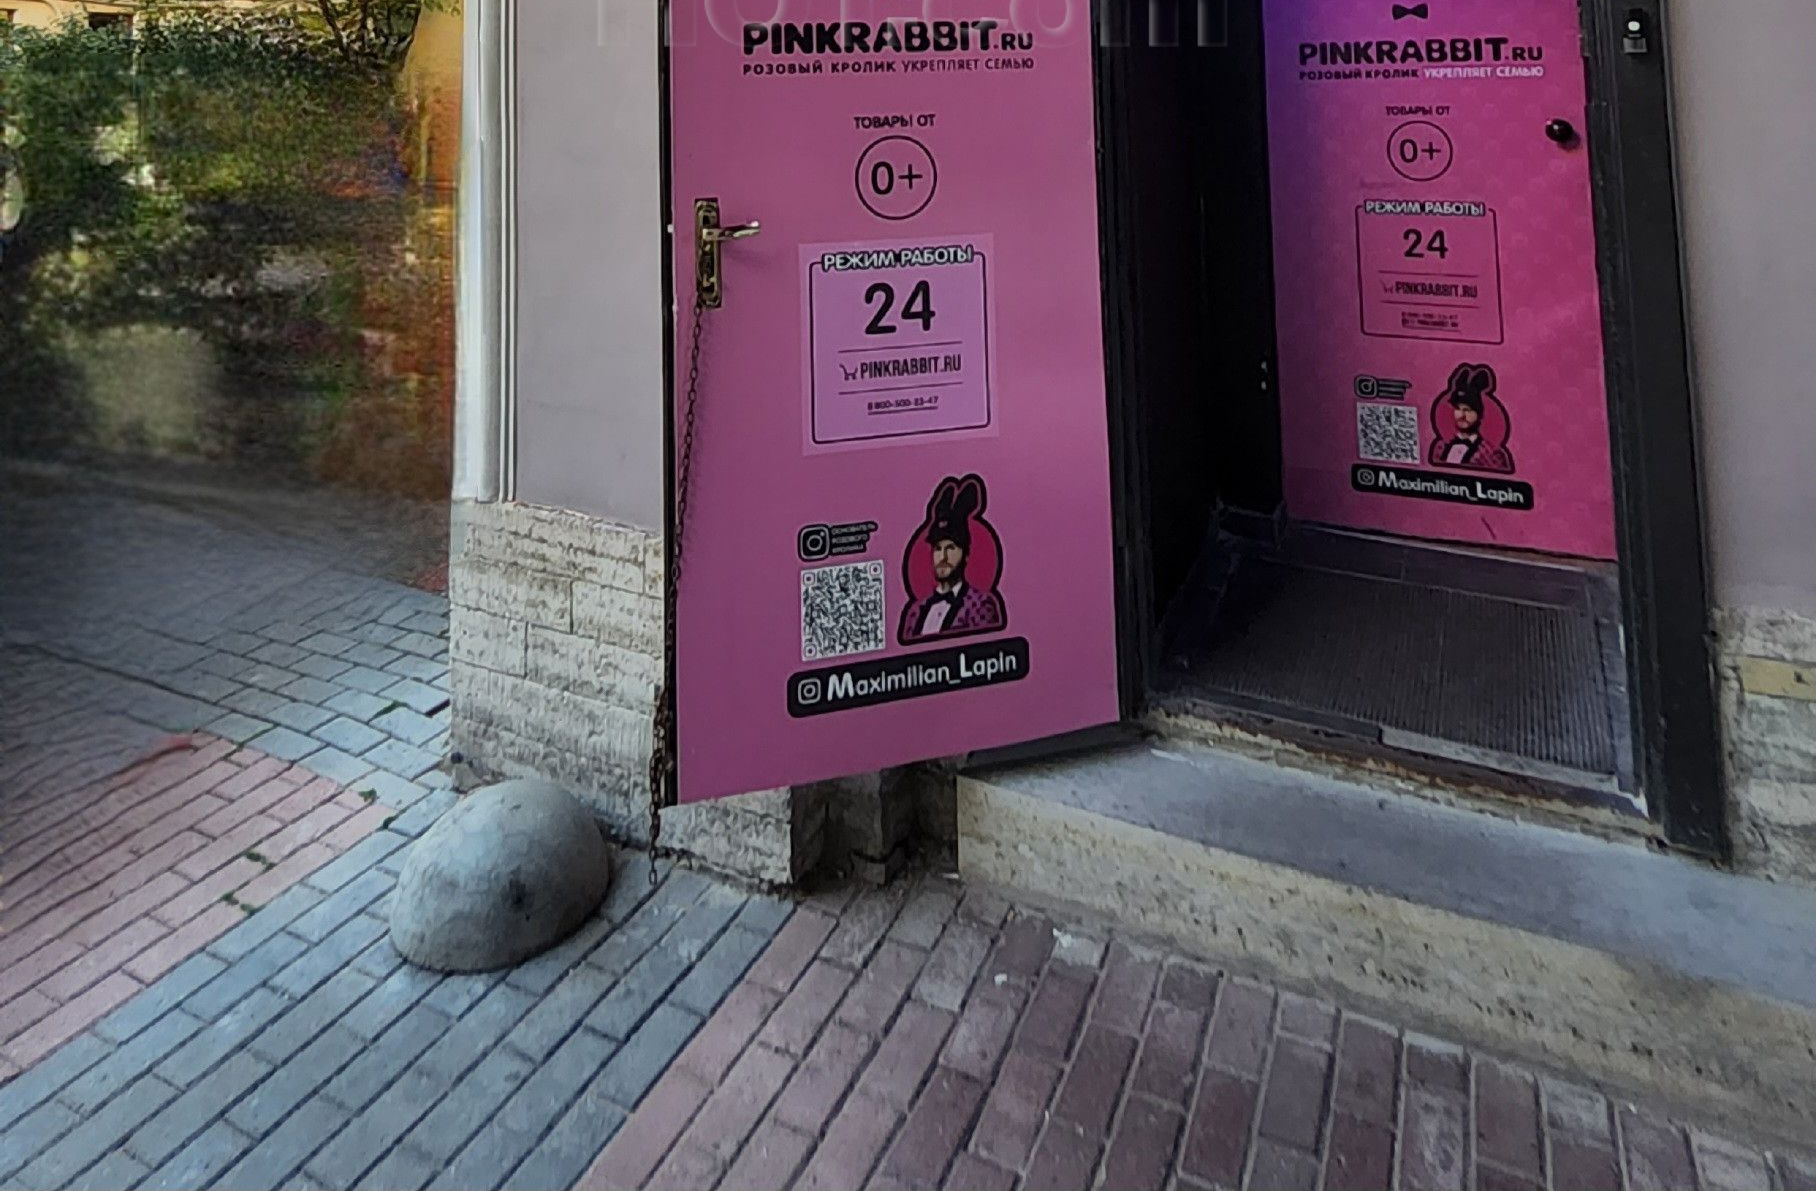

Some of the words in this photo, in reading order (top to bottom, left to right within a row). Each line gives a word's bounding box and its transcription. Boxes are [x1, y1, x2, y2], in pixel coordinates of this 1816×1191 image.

[742, 20, 1033, 55] PINKRABBIT.RU
[1298, 37, 1543, 66] PINKRABBIT.RU
[742, 60, 823, 76] РОЗОВЫЙ
[831, 60, 897, 74] КРОЛИК
[902, 58, 980, 73] УКРЕПЛЯЕТ
[985, 57, 1035, 71] СЕМЬЮ
[1299, 69, 1362, 81] РОЗОВЫЙ
[1365, 68, 1419, 80] КРОЛИК
[1423, 67, 1492, 79] УКРЕПЛЯЕТ
[1496, 66, 1544, 78] СЕМЬЮ
[854, 114, 913, 129] ТОВАРЫ
[916, 114, 936, 127] ОТ
[1385, 106, 1433, 117] ТОВАРЫ
[1435, 106, 1451, 116] ОТ
[1398, 139, 1442, 164] 0+
[870, 161, 924, 196] 0+
[1365, 200, 1421, 214] РЕЖИМ
[1424, 201, 1485, 216] РАБОТЫ
[1403, 229, 1448, 260] 24
[823, 251, 895, 270] РЕЖИМ
[900, 246, 973, 266] РАБОТЫ
[864, 280, 936, 336] 24
[860, 354, 963, 380] PINKRABBIT.RU
[1378, 470, 1525, 505] Maximilian_Lapin
[827, 651, 1018, 702] Maximilian_Lapin
